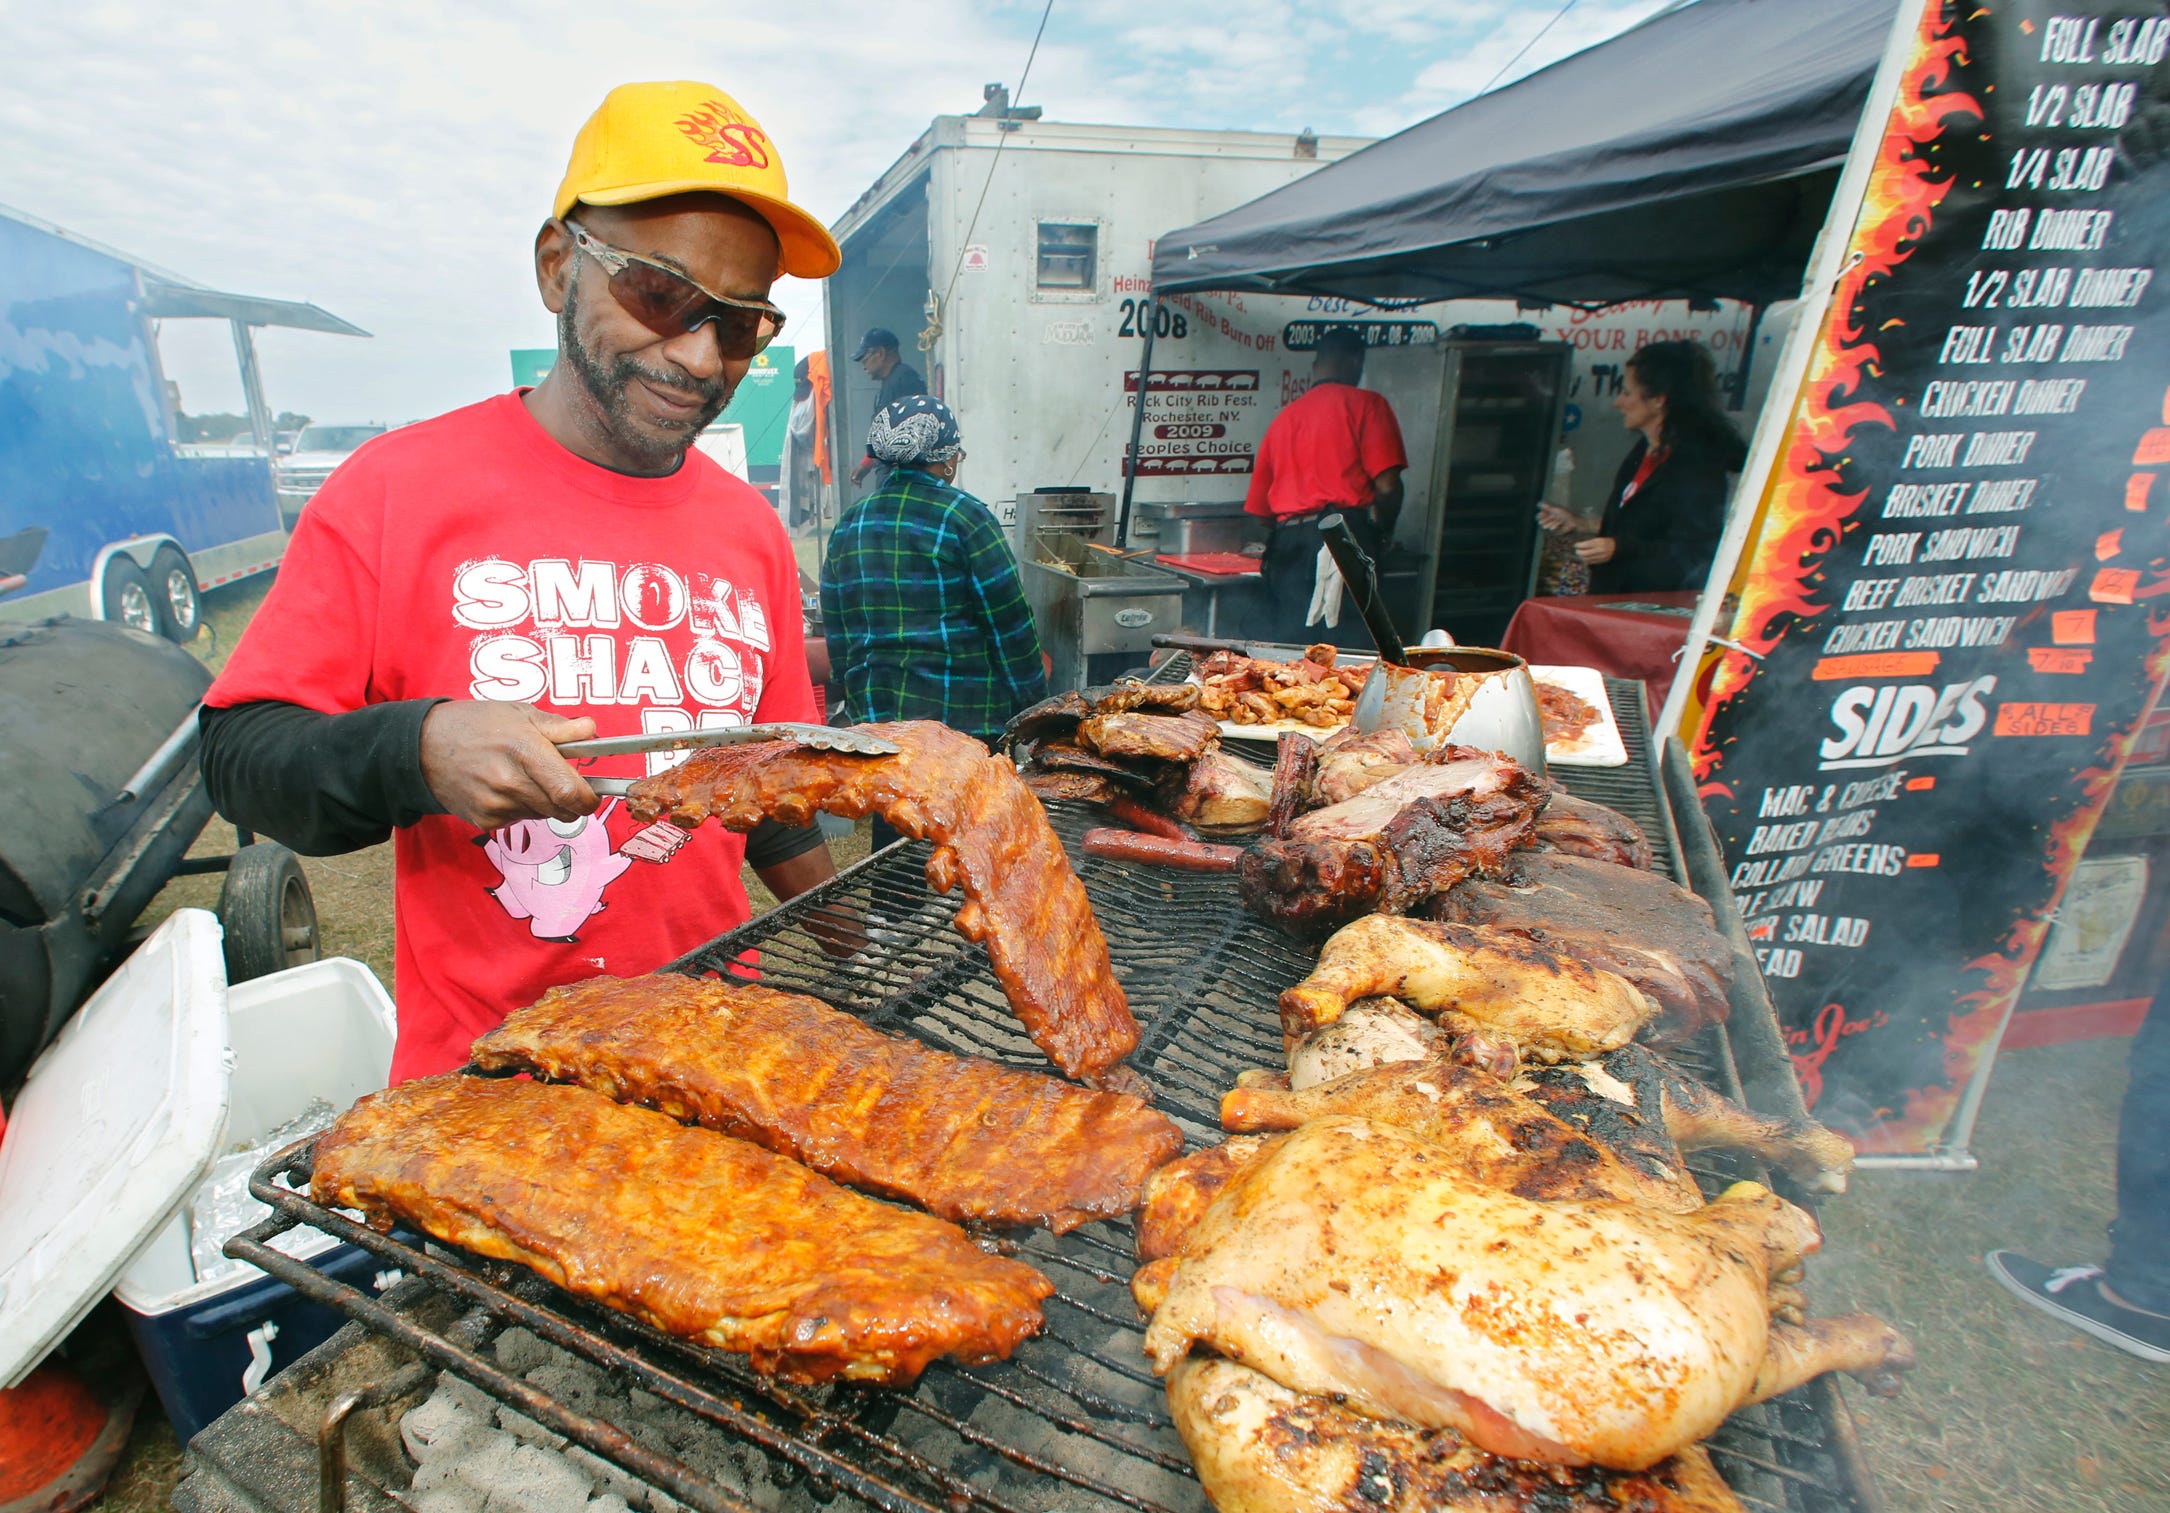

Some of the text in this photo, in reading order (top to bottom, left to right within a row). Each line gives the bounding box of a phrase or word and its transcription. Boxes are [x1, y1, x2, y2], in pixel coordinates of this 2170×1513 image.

[2039, 17, 2170, 65] FULL SLAB
[2025, 82, 2138, 129] 1/2 SLAB
[2005, 147, 2115, 191] 1/4 SLAB
[1981, 208, 2113, 251] RIB DINNER
[1113, 276, 1152, 294] Heinz
[1962, 267, 2153, 309] 1/2 SLAB DINNER
[1118, 298, 1188, 339] 2008
[1195, 301, 1218, 329] Rib
[1220, 317, 1252, 348] Burn
[1255, 334, 1276, 352] Off
[1288, 324, 1316, 346] 2003
[1556, 328, 1626, 351] YOUR
[1938, 323, 2135, 364] FULL SLAB DINNER
[1127, 394, 1258, 408] Rck City Rib Fest.
[1919, 378, 2087, 418] CHICKEN DINNER
[1166, 425, 1214, 438] 2009
[1196, 440, 1252, 454] Choice
[1901, 431, 2037, 469] PORK DINNER
[1881, 478, 2038, 519] BRISKET DINNER
[1861, 525, 2021, 567] PORK SANDWICH
[452, 555, 771, 653] SMOKE
[1841, 577, 1898, 612] BEEF
[1893, 572, 1977, 608] BRISKET
[1822, 616, 2018, 655] CHICKEN SANDWICH
[1818, 674, 1998, 760] SIDES
[2008, 721, 2080, 735] SIDES
[2018, 704, 2073, 722] ALL
[1757, 784, 1816, 819] MAC
[1814, 783, 1838, 814] &
[1744, 820, 1822, 856] BAKED
[1810, 842, 1906, 877] GREENS
[1782, 913, 1871, 948] SALAD
